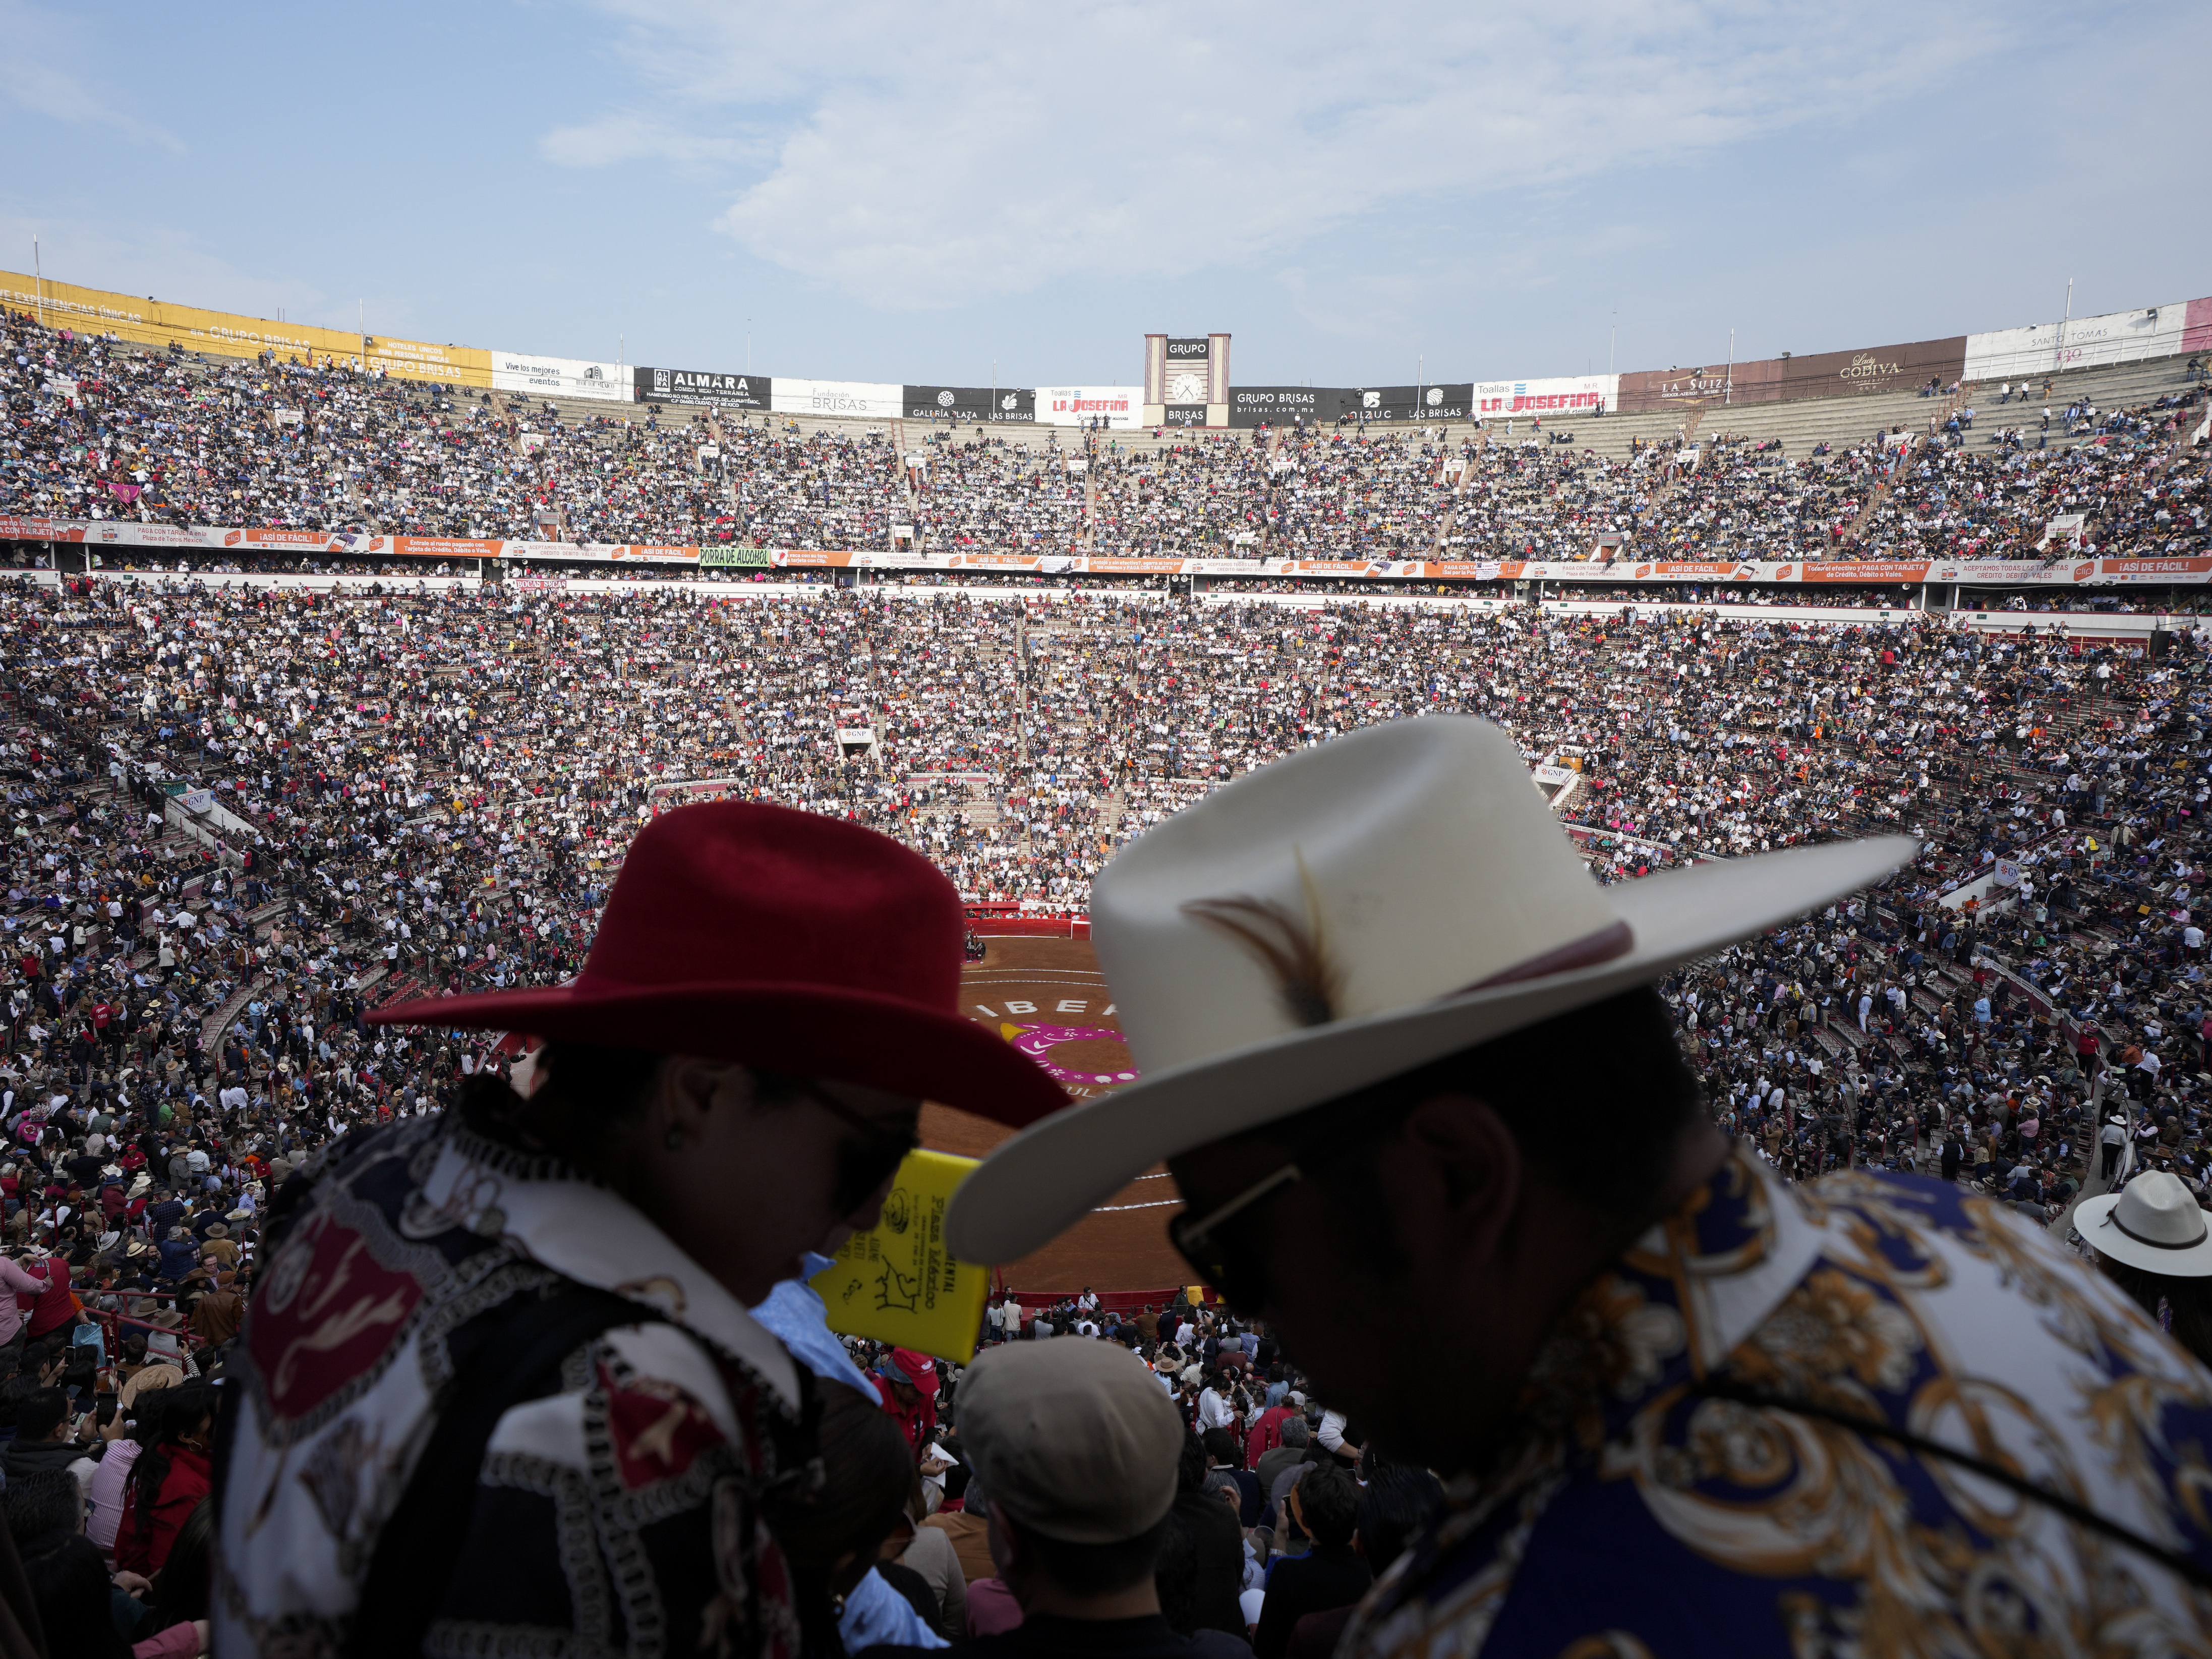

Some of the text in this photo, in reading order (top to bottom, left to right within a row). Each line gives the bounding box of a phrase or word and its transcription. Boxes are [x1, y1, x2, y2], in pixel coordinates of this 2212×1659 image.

[15, 291, 141, 324] EXPERIENCIAS ÚNICAS
[210, 326, 260, 344] GRUPO
[264, 334, 310, 352] BRISAS
[2031, 334, 2064, 347] SANTO
[387, 341, 442, 355] HOTELES UNICOS
[1170, 344, 1206, 355] GRUPO
[394, 351, 424, 360] PERSONAS
[427, 355, 449, 363] UNICAS
[1852, 353, 1876, 368] Lady
[370, 357, 461, 378] GRUPO BRISAS
[505, 362, 560, 375] Vive los mejores
[1840, 363, 1901, 378] GODIVA
[530, 377, 560, 386] eventos
[674, 372, 748, 390] ALMARA
[1662, 379, 1734, 392] LA SUIZA
[813, 388, 849, 397] Fundación
[1478, 385, 1509, 393] Toallas
[813, 397, 866, 411] BRISAS
[1238, 393, 1314, 404] GRUPO BRISAS
[1053, 400, 1066, 411] LA
[1481, 397, 1501, 412] LA
[1169, 411, 1203, 421] BRISAS
[1409, 408, 1462, 418] LAS BRISAS
[226, 534, 240, 542] clip
[277, 533, 286, 541] DE
[288, 533, 312, 542] FÁCIL!
[665, 548, 685, 556] FÁCIL!
[700, 549, 768, 564] PORRA DE ALCOHOL
[1695, 564, 1718, 572] FÁCIL!
[2076, 566, 2092, 576] clip
[2119, 560, 2189, 571] ¡ASÍ DE FÁCIL!
[189, 794, 204, 805] GNP
[2008, 867, 2019, 878] GN
[924, 1195, 945, 1310] Plaza México
